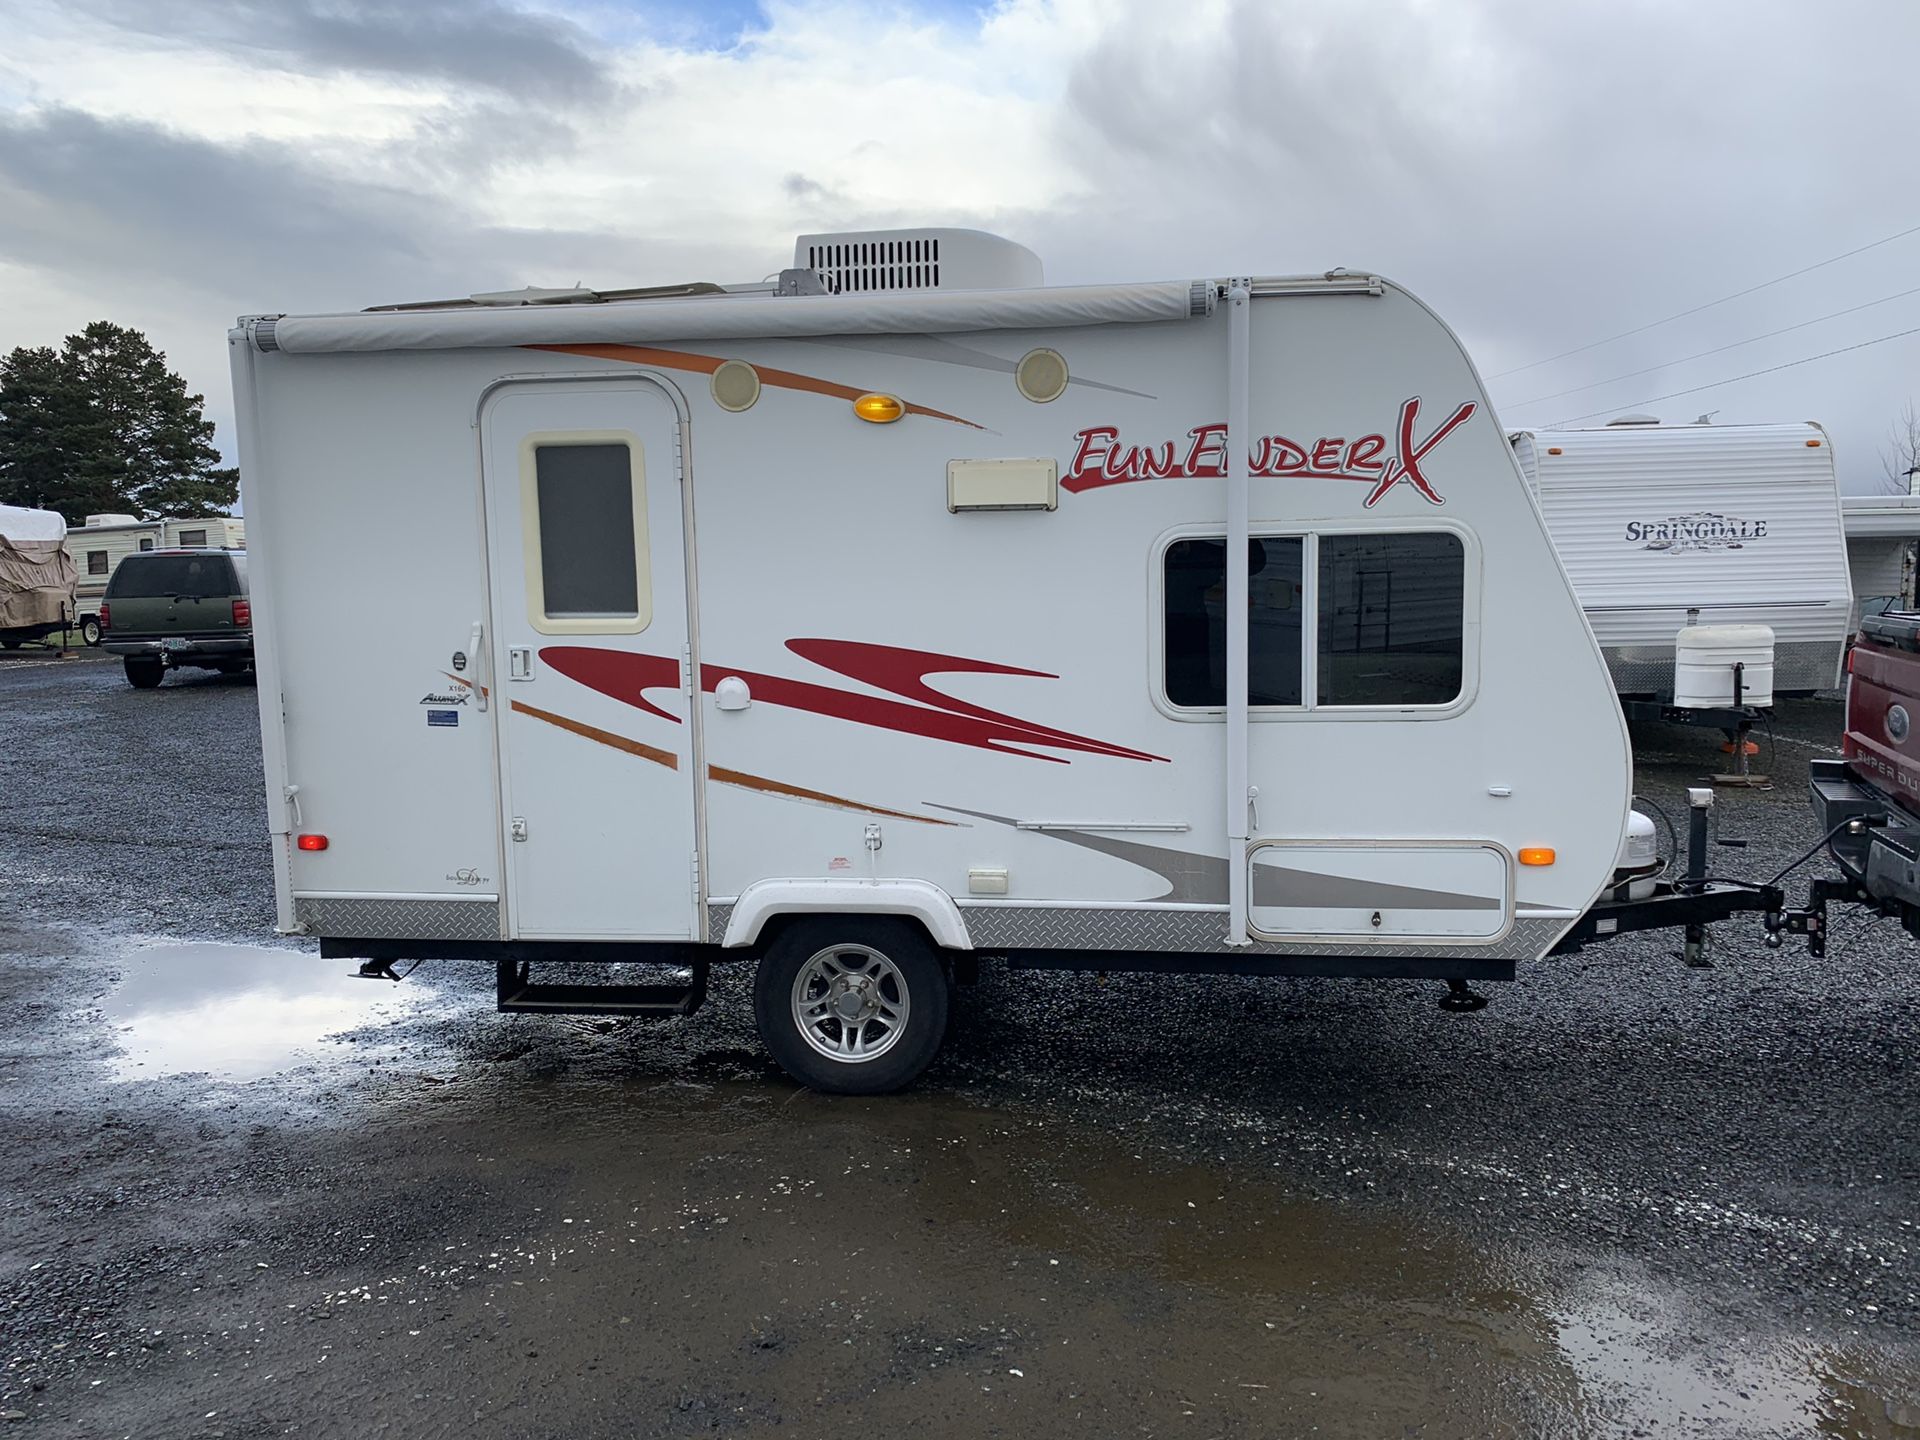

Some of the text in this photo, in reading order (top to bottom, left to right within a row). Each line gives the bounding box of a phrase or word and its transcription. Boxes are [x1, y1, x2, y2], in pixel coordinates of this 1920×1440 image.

[1183, 423, 1385, 477] FNDER
[1363, 395, 1478, 508] X
[1625, 520, 1768, 542] SPRINGDALE
[1856, 748, 1920, 791] SUPER DU
